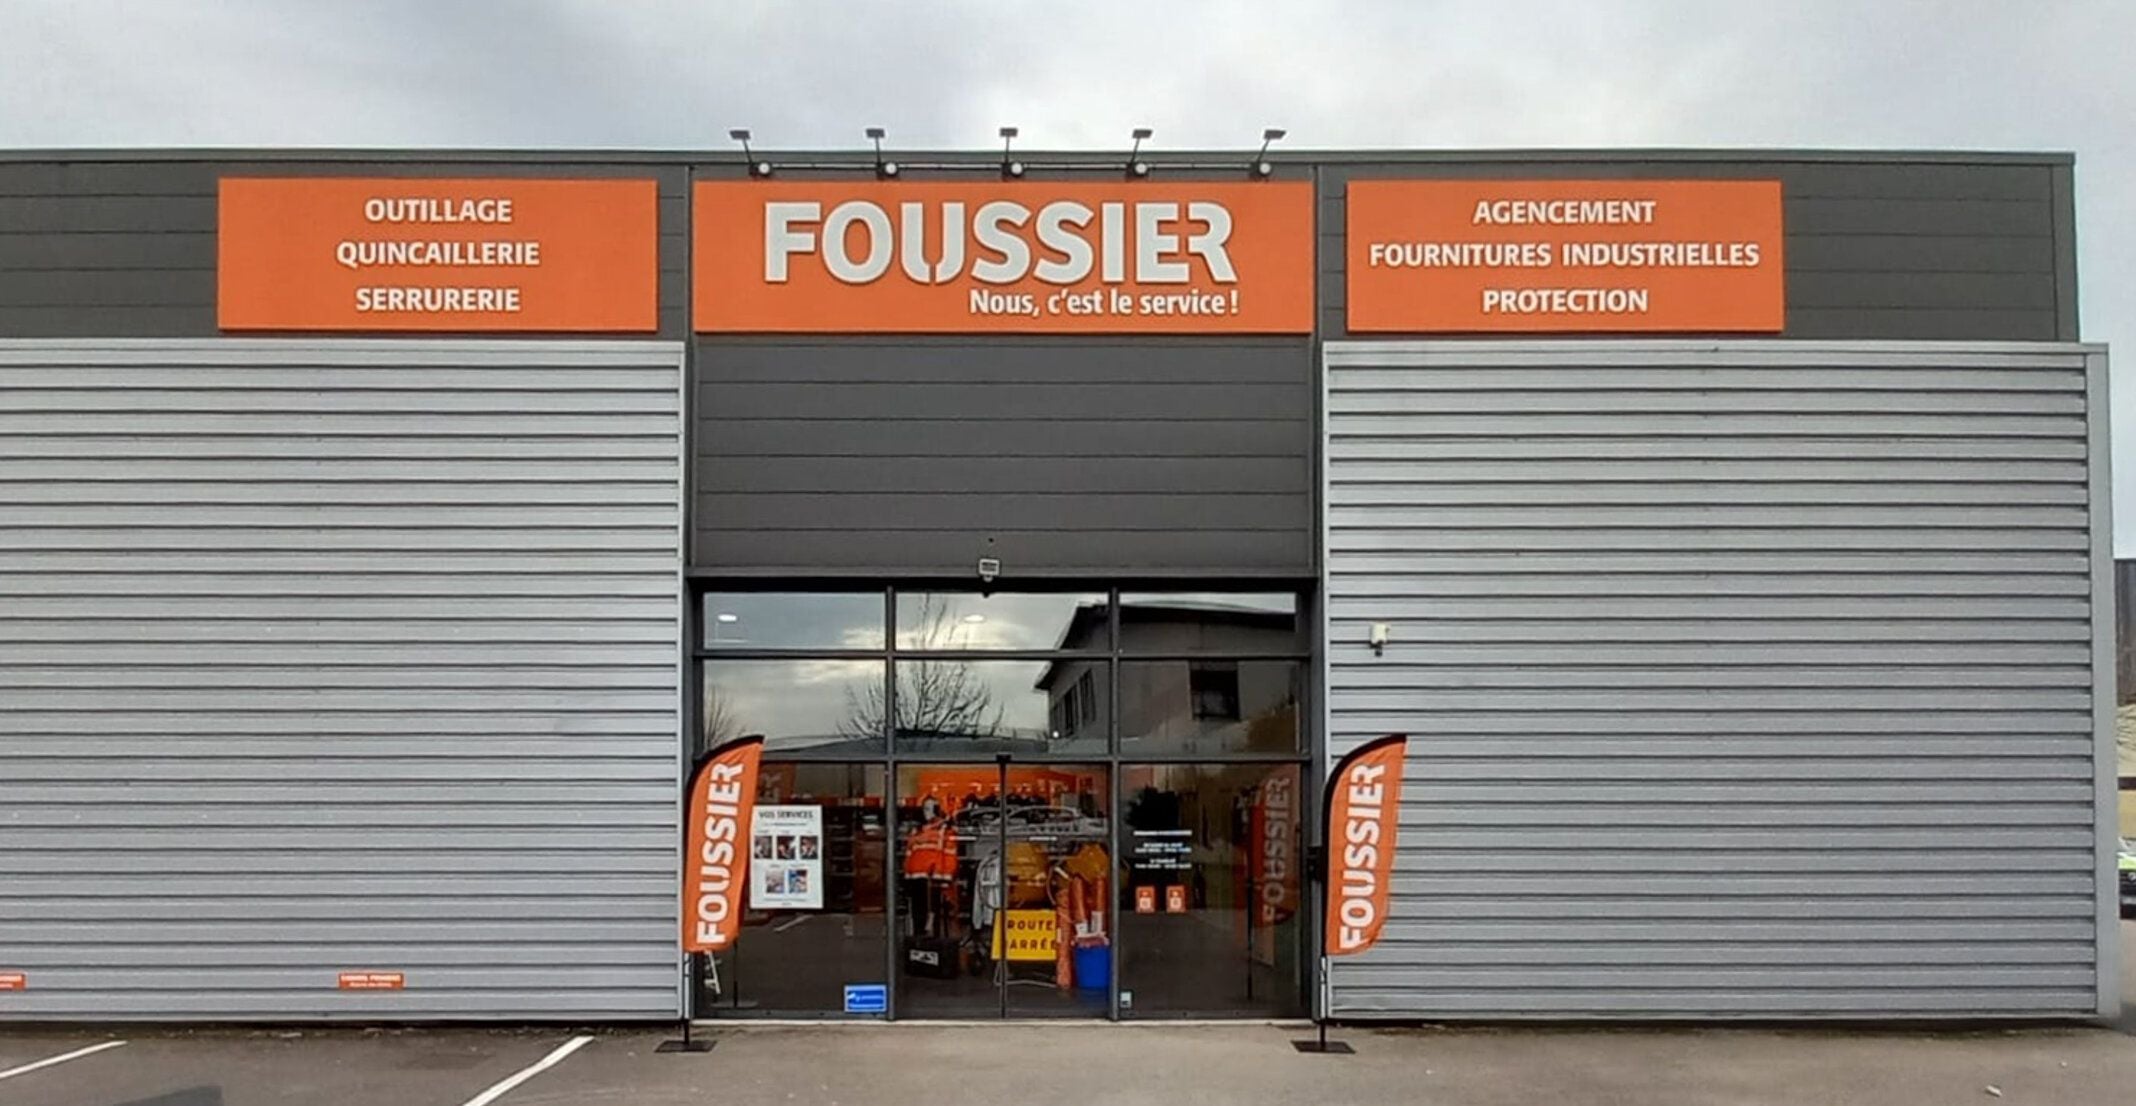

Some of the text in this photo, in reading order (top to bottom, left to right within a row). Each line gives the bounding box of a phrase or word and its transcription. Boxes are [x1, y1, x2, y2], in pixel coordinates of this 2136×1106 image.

[364, 199, 512, 223] OUTILLAGE
[1472, 200, 1656, 224] AGENCEMENT
[764, 200, 1238, 284] FOUSSIER
[336, 241, 540, 269] QUINCAILLERIE
[1369, 243, 1760, 267] FOURNITURES INDUSTRIELLES
[356, 287, 521, 312] SERRURERIE
[970, 288, 1040, 317] Nous,
[1047, 288, 1103, 314] c'est
[1110, 288, 1133, 314] le
[1482, 289, 1649, 313] PROTECTION
[696, 762, 744, 944] FOUSSIER
[1339, 764, 1386, 949] FOUSSIER
[1007, 919, 1054, 932] ROUTE
